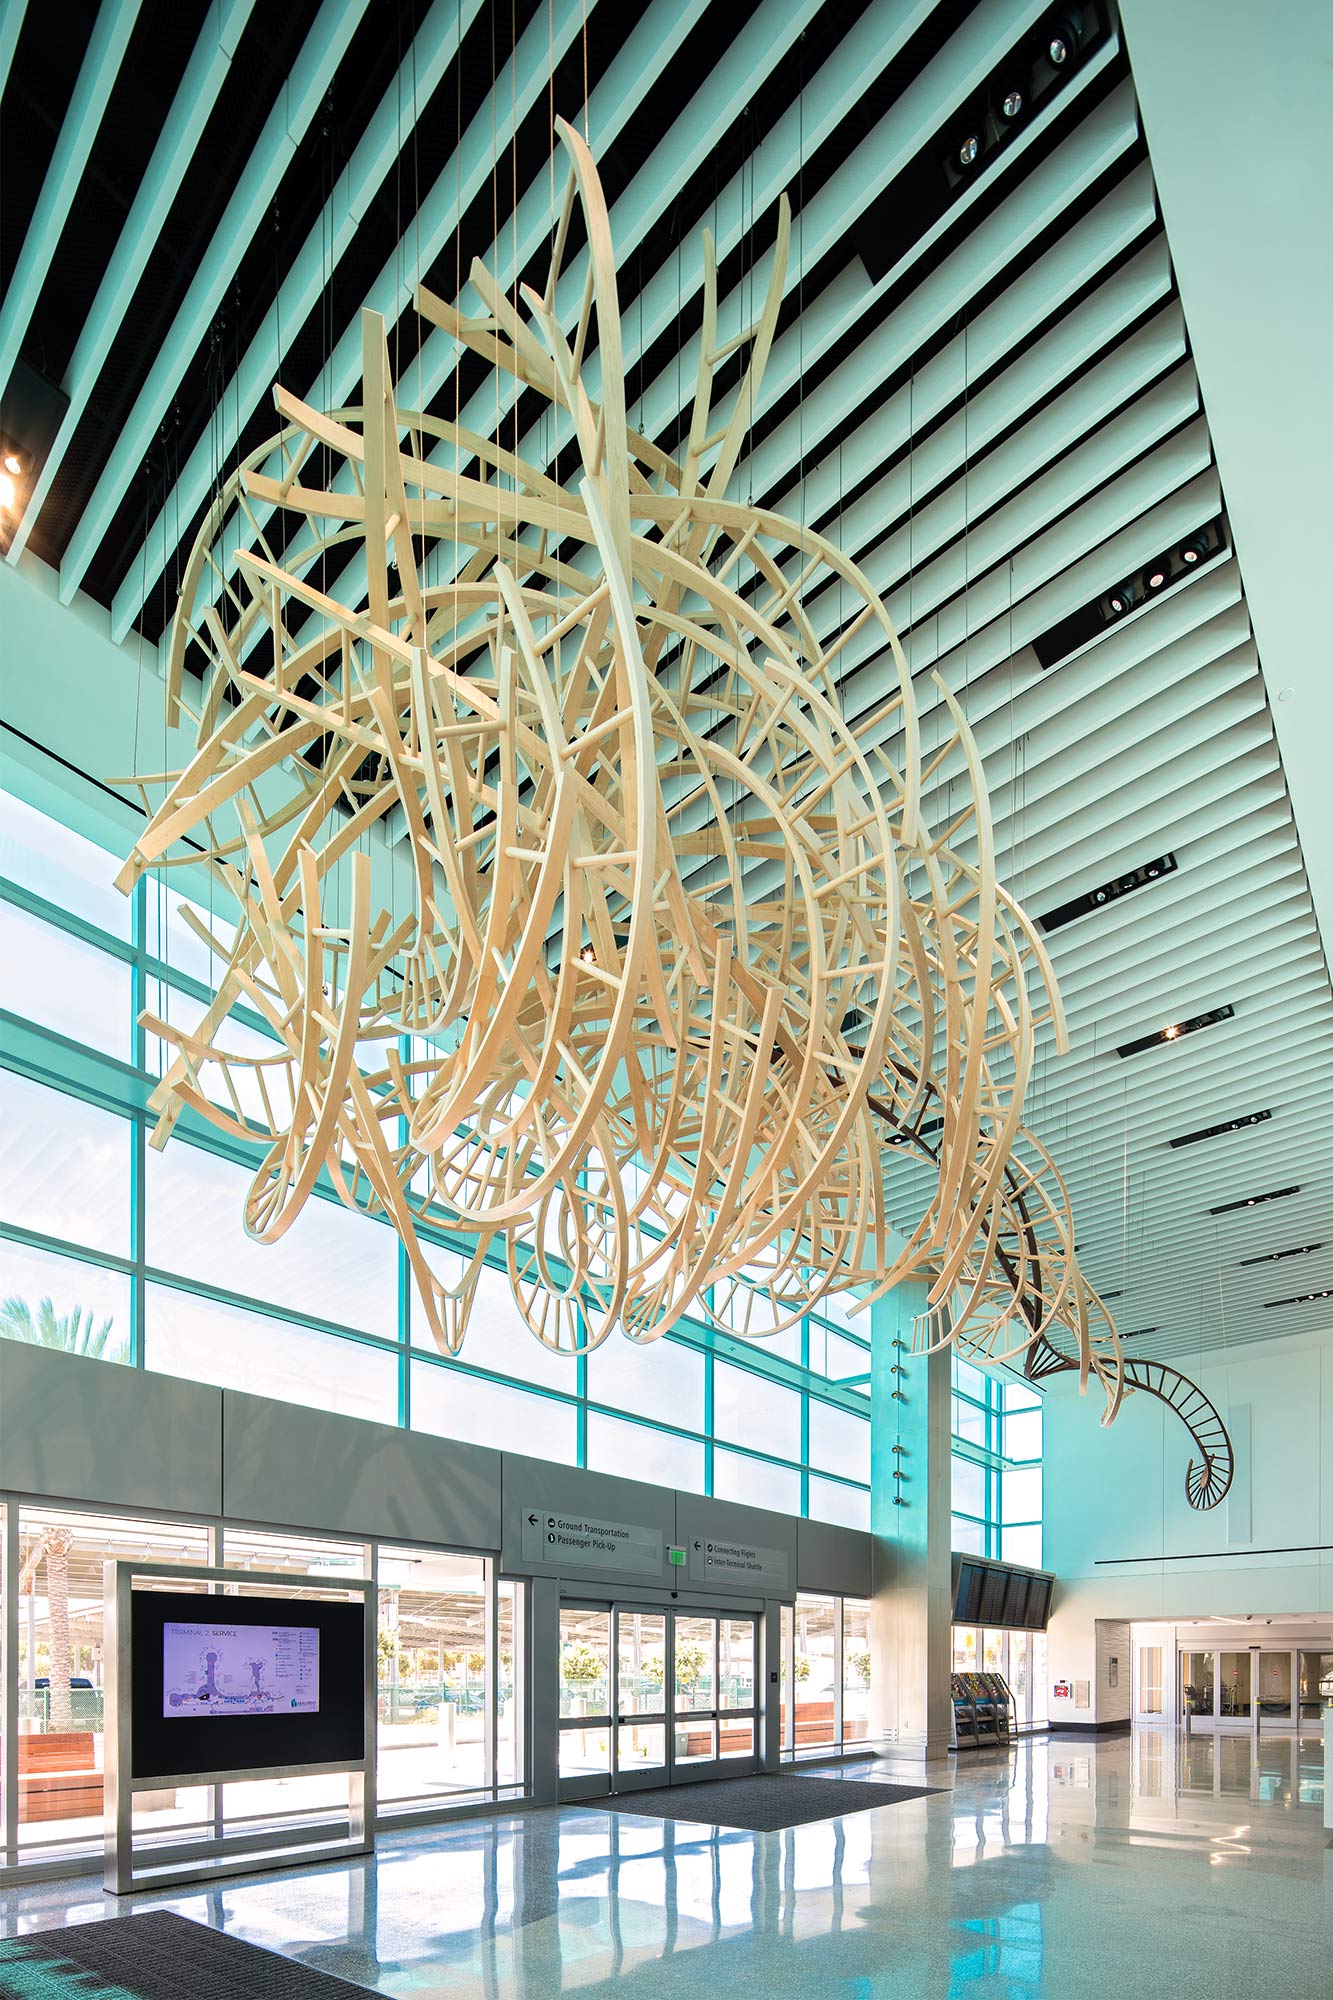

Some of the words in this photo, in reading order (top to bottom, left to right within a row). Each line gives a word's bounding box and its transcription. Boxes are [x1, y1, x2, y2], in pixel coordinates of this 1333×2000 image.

[557, 1520, 582, 1532] Ground
[584, 1524, 629, 1539] Transportation
[557, 1534, 591, 1548] Passenger
[593, 1540, 616, 1552] Pick-Up
[714, 1545, 740, 1557] Connecting
[741, 1549, 756, 1559] Flights
[714, 1558, 746, 1569] Inter-Terminal
[747, 1561, 762, 1571] Shuttle
